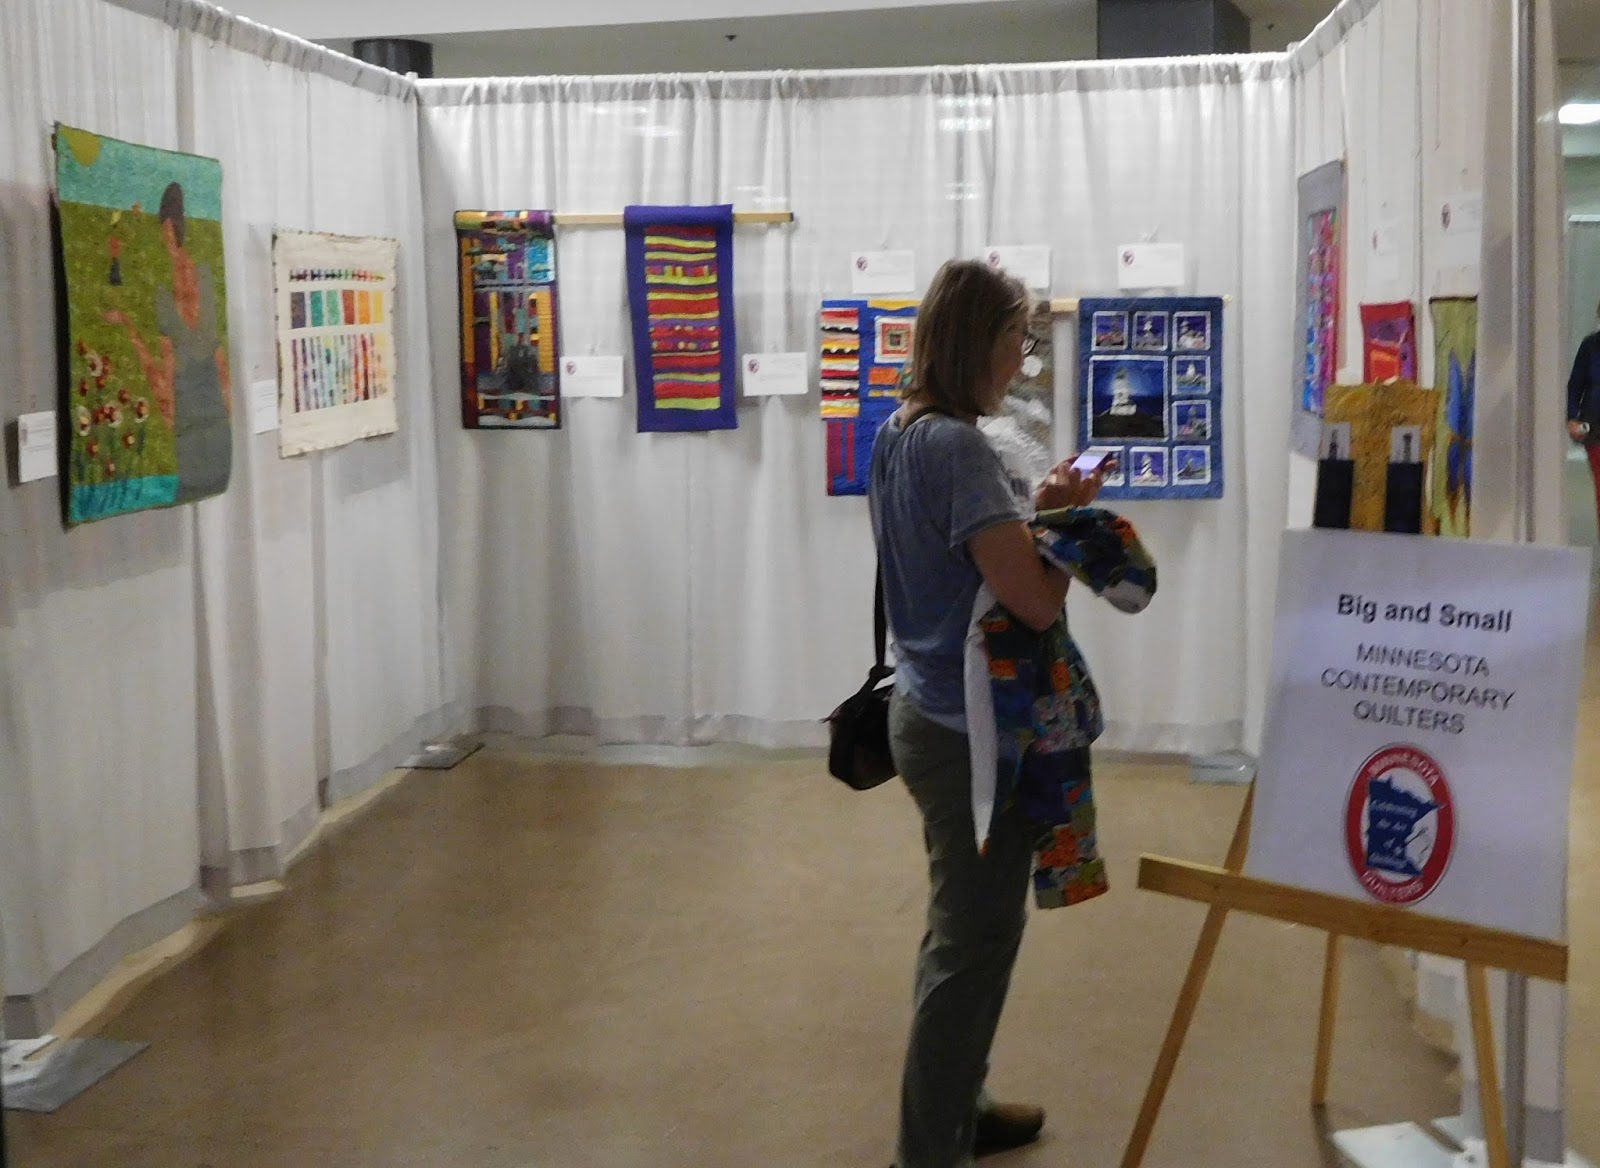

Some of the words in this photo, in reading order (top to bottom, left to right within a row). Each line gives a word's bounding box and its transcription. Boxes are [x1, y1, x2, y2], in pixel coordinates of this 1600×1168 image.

[1338, 593, 1377, 624] Big
[1385, 602, 1431, 623] and
[1439, 603, 1512, 632] Small
[1356, 643, 1490, 677] MINNESOTA
[1321, 668, 1515, 711] CONTEMPORARY
[1354, 700, 1465, 734] QUILTERS
